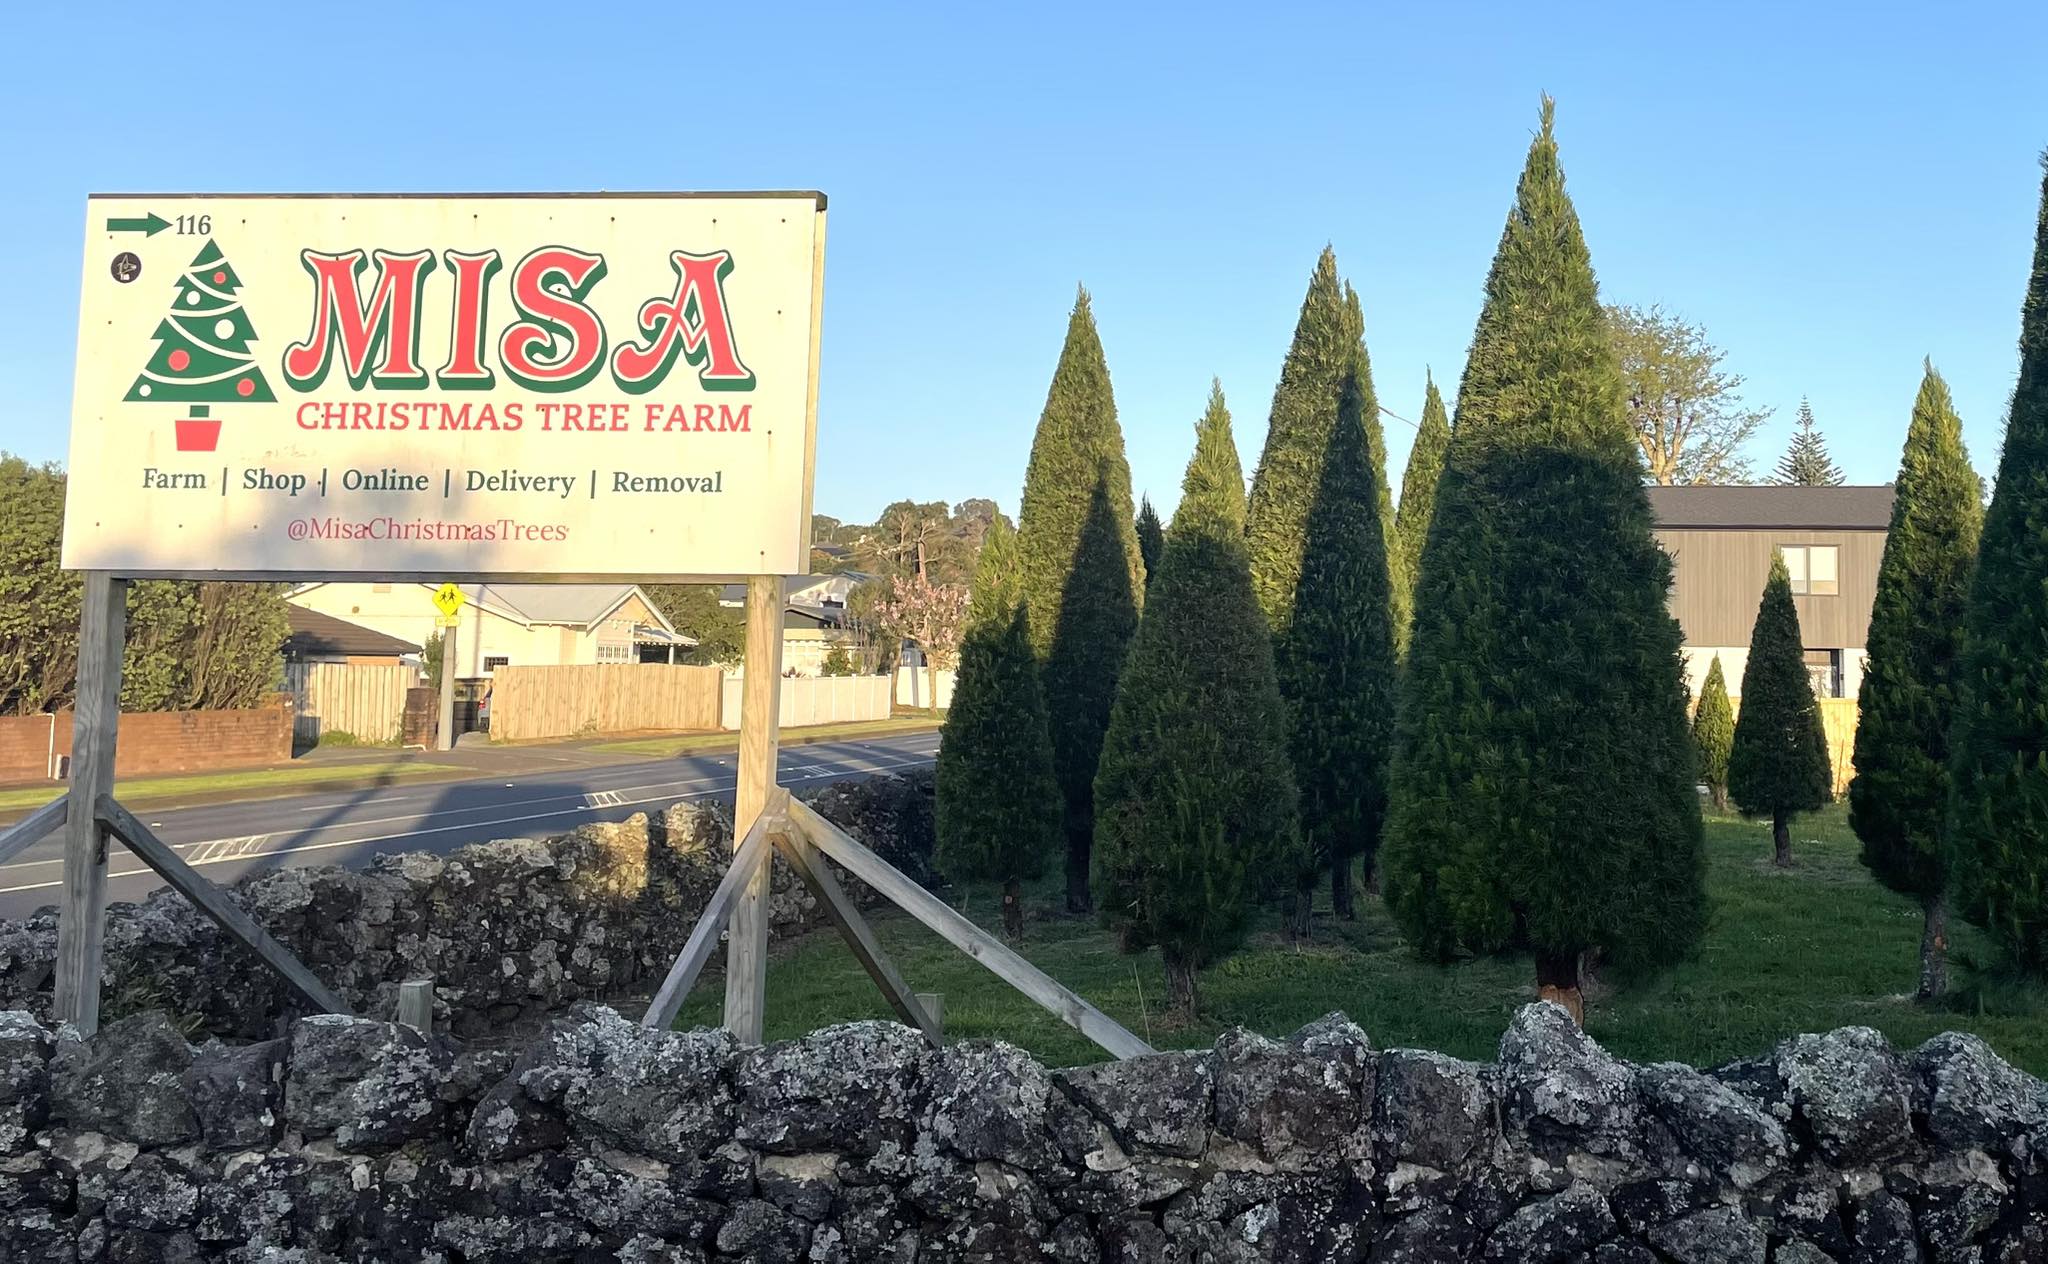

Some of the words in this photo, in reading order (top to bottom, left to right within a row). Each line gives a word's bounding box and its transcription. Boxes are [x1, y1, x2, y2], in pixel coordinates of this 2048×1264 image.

[176, 214, 212, 235] 116
[282, 245, 757, 395] MISA
[296, 402, 523, 431] CHRISTMAS
[535, 403, 630, 431] TREE
[643, 404, 753, 432] FARM
[142, 467, 207, 489] Farm
[242, 467, 306, 497] Shop
[342, 468, 429, 492] Online
[465, 470, 577, 501] Delivery
[611, 470, 723, 493] Removal
[287, 516, 567, 542] @MisaChristmasTrees
